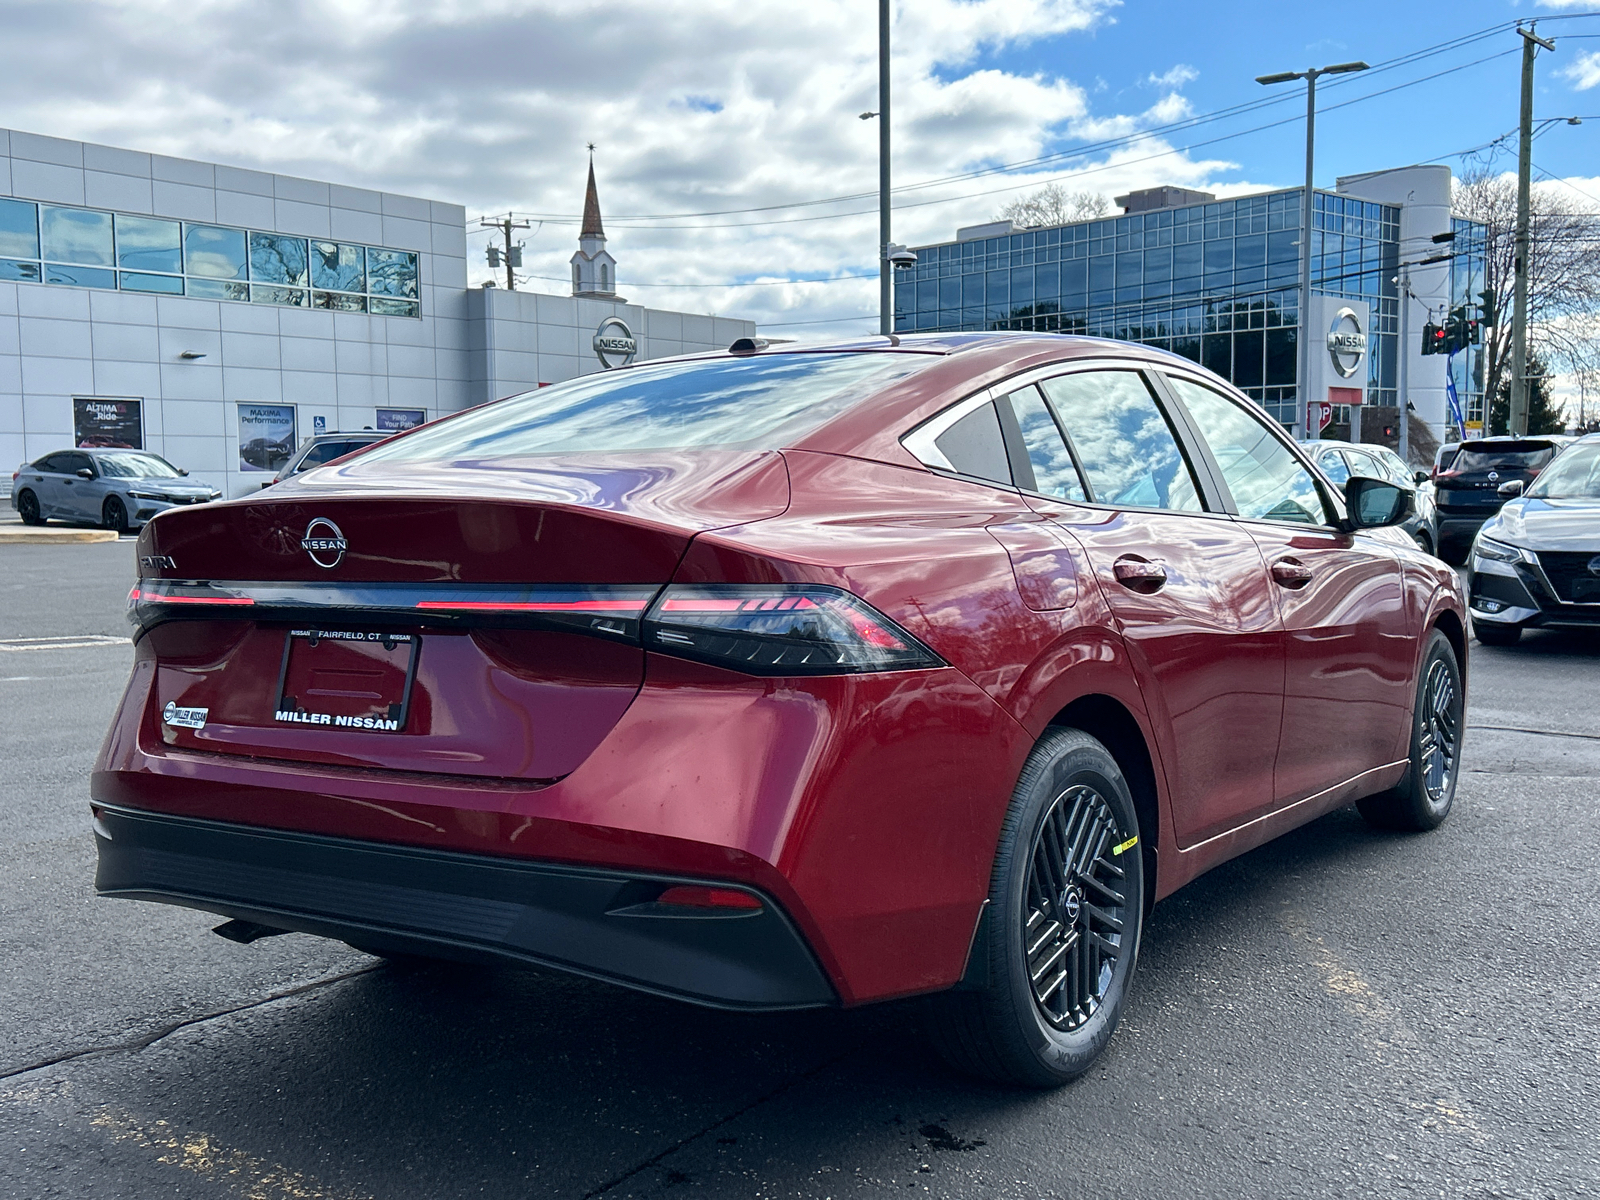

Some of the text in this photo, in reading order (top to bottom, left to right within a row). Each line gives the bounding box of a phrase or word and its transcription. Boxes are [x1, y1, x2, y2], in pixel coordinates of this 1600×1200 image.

[600, 338, 635, 351] NISSAN
[1334, 335, 1365, 349] NISSAN
[86, 403, 118, 413] ALTIMA
[249, 409, 282, 417] MAXIMA
[97, 412, 117, 421] Ride
[241, 416, 290, 425] Performance
[384, 420, 415, 428] Your Path
[301, 540, 347, 550] NISSAN
[318, 630, 365, 641] FAIRFIELD,
[367, 632, 382, 640] CT
[275, 710, 398, 731] MILLER NISSAN
